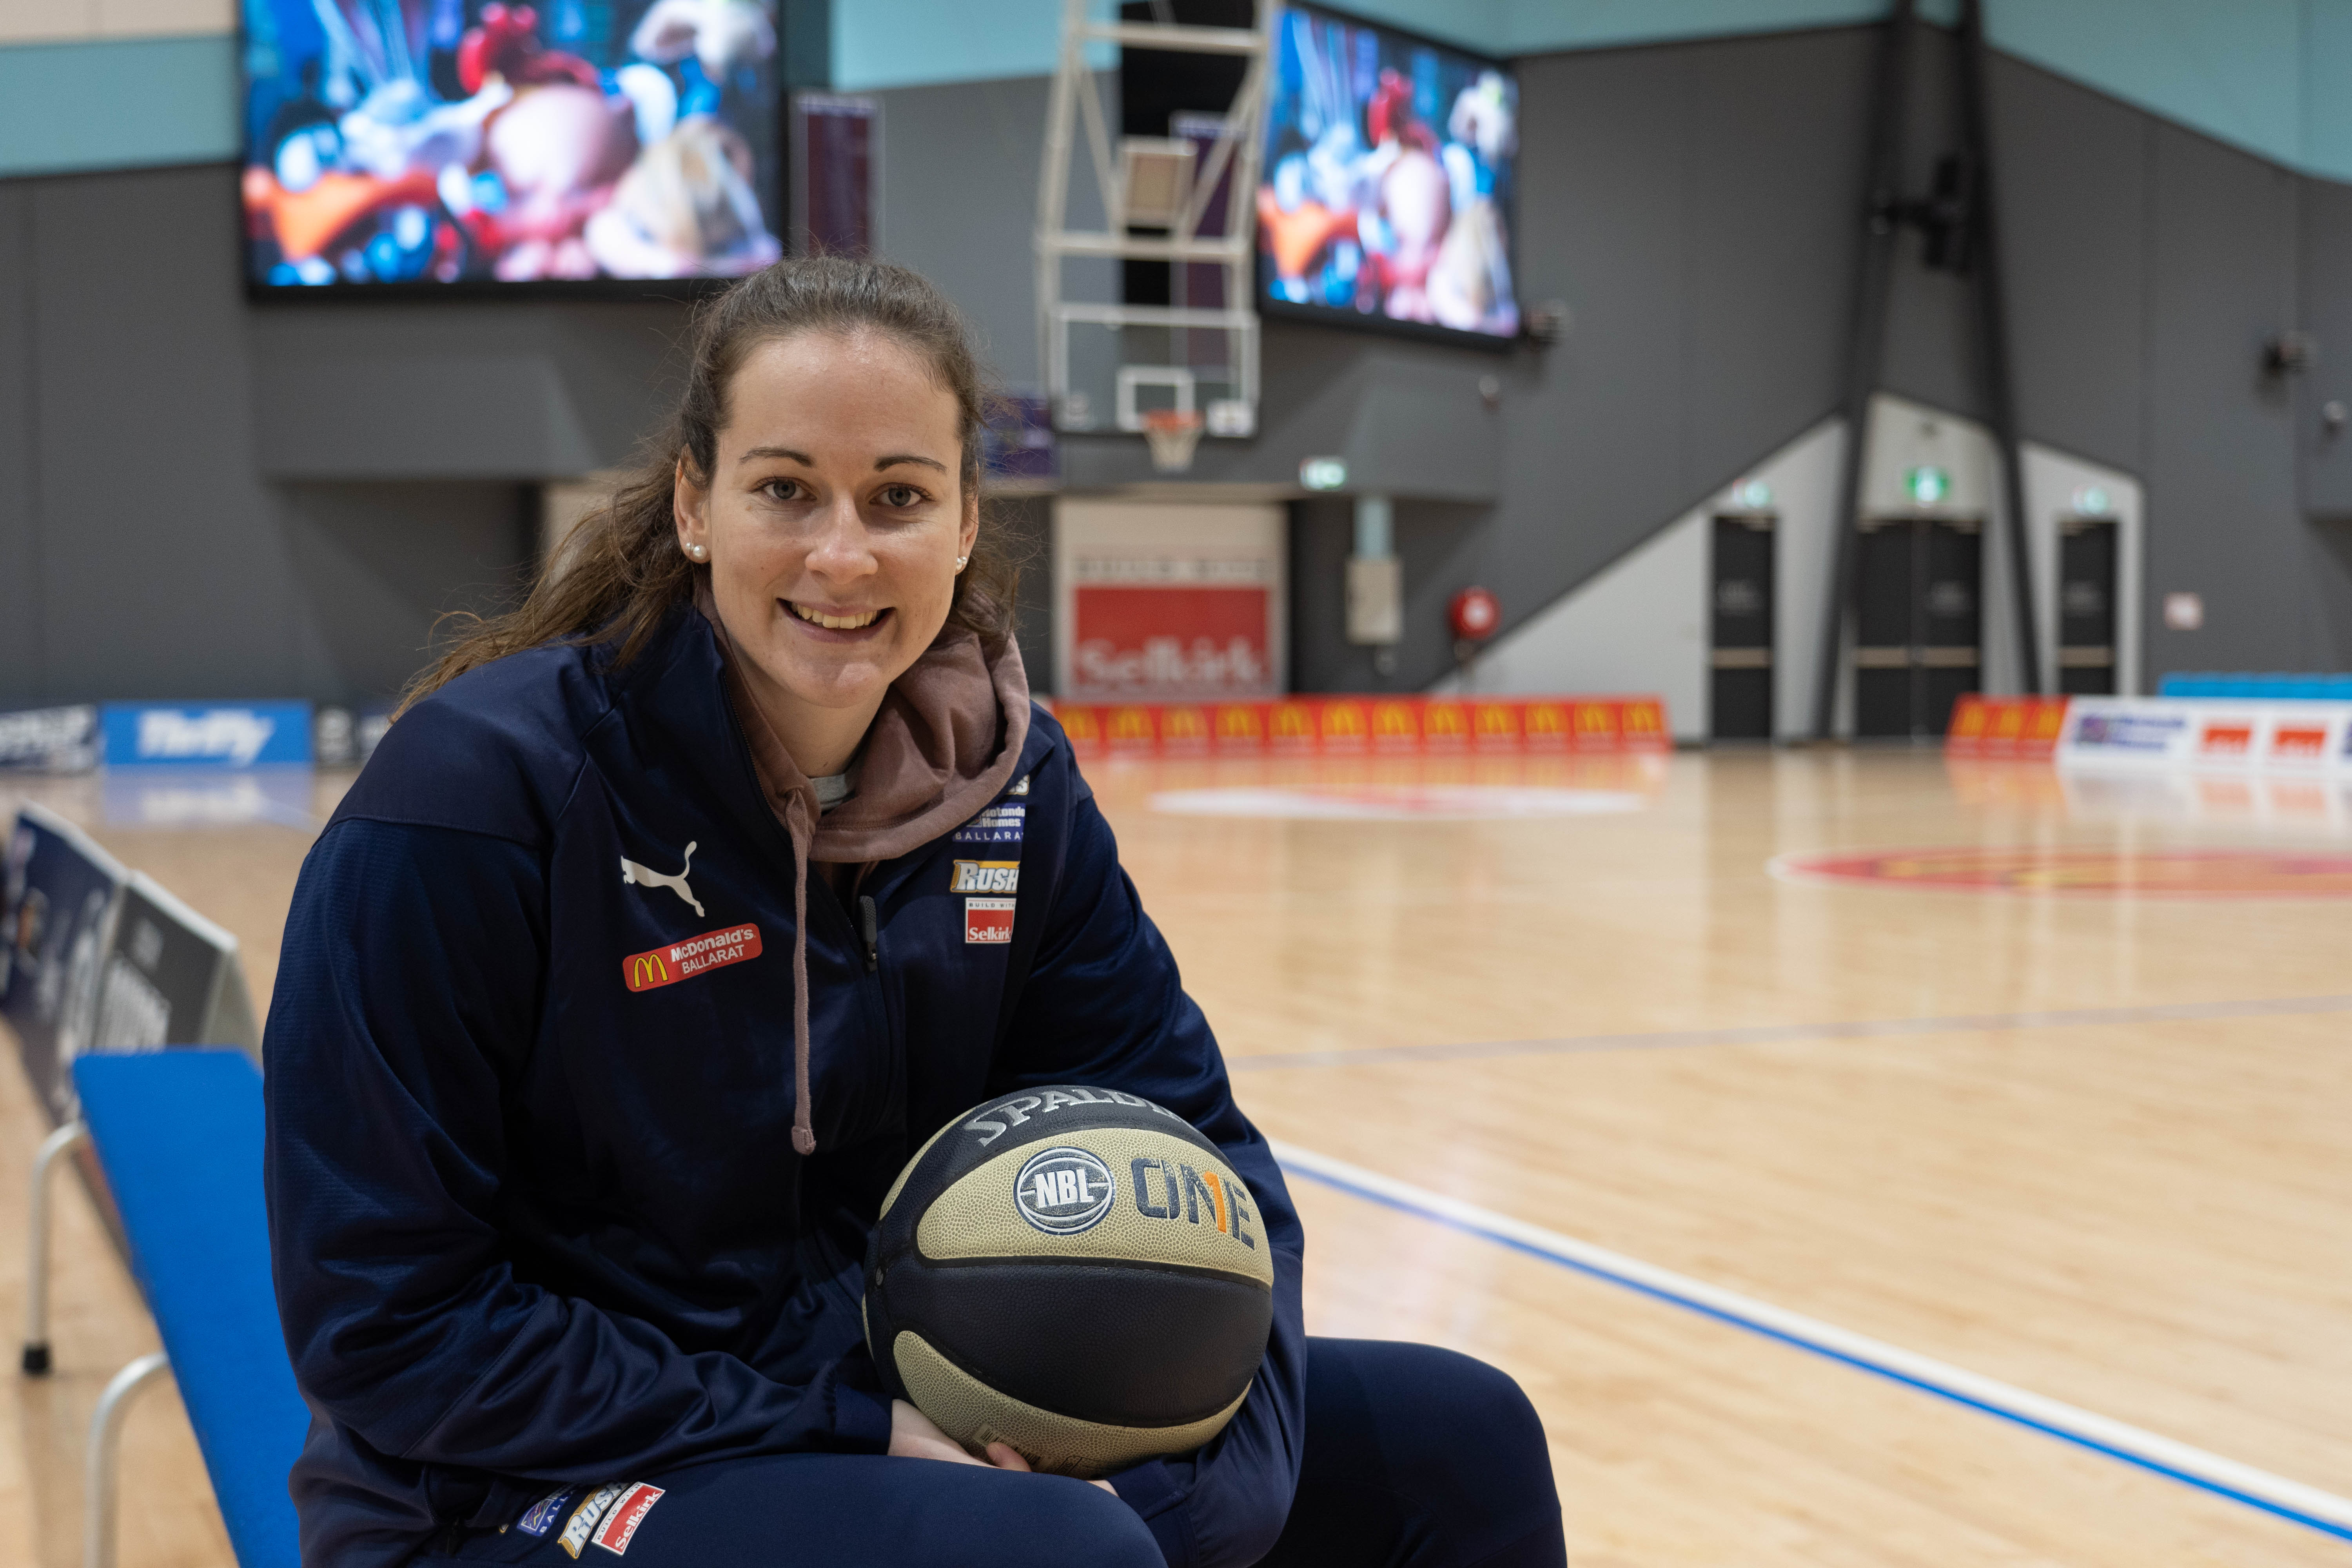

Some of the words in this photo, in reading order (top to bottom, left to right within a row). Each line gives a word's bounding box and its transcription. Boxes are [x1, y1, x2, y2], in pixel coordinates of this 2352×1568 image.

[955, 831, 1024, 841] BALLARA
[982, 818, 1021, 828] Homes
[953, 861, 1019, 892] RUSH
[671, 928, 755, 962] McDonald's
[969, 926, 1011, 941] Selkirk
[681, 944, 745, 975] BALLARAT
[1035, 1168, 1094, 1209] NBL
[597, 1509, 617, 1540] BUILD
[620, 1484, 641, 1504] WITH
[615, 1491, 661, 1549] Selkirk
